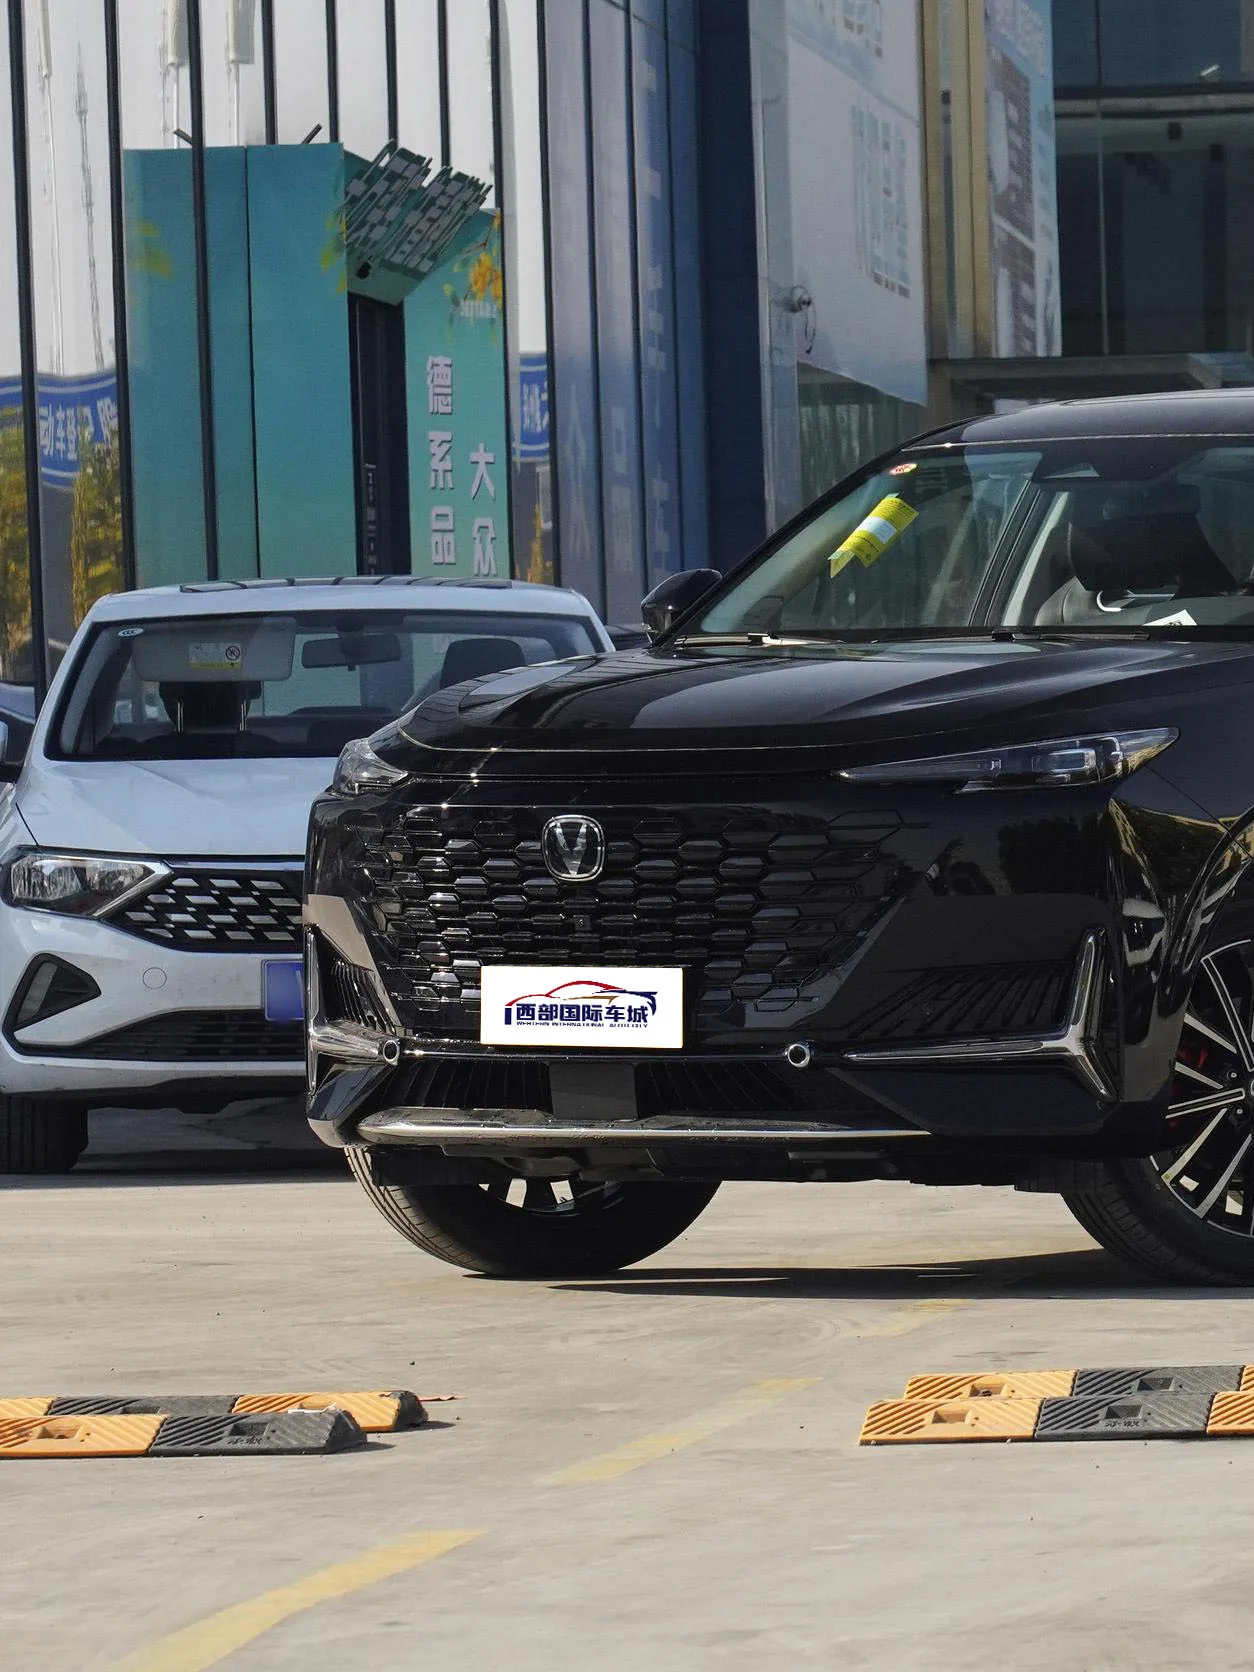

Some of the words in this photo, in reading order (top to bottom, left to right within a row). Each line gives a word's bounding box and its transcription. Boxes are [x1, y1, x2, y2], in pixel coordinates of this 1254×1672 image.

[427, 355, 456, 566] 德系品
[468, 442, 498, 577] 大众
